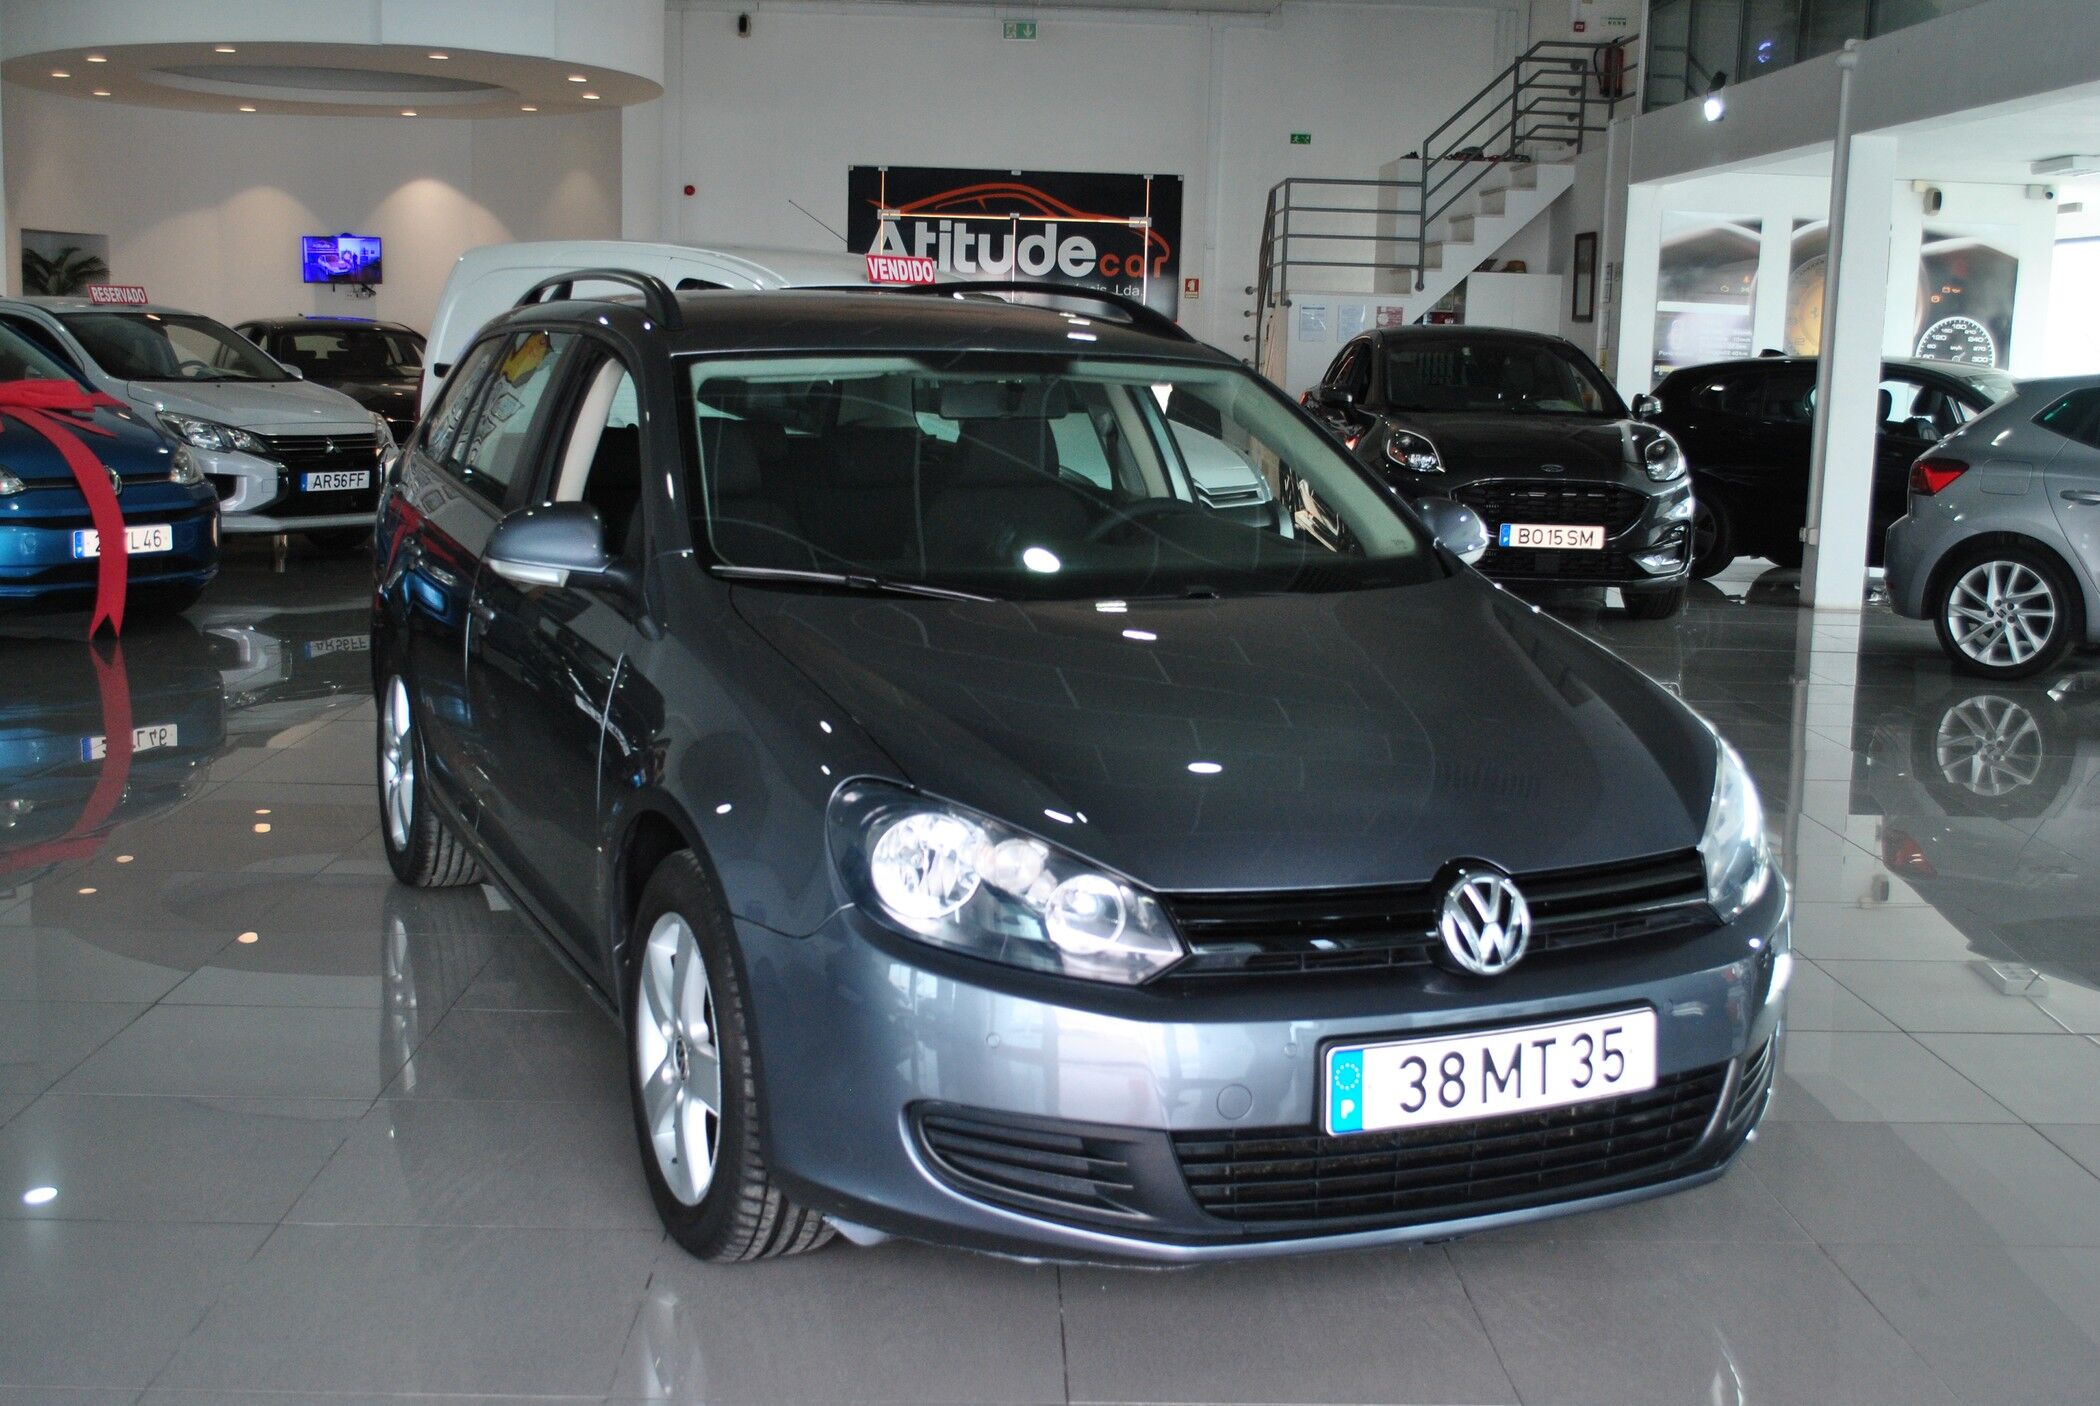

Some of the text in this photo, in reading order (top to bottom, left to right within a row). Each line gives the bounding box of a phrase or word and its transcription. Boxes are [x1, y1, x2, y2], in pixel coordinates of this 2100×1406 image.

[868, 220, 1097, 278] Atitude
[866, 257, 933, 282] VENDIDO
[91, 286, 146, 303] RESERVADO
[313, 473, 365, 489] AR56FF
